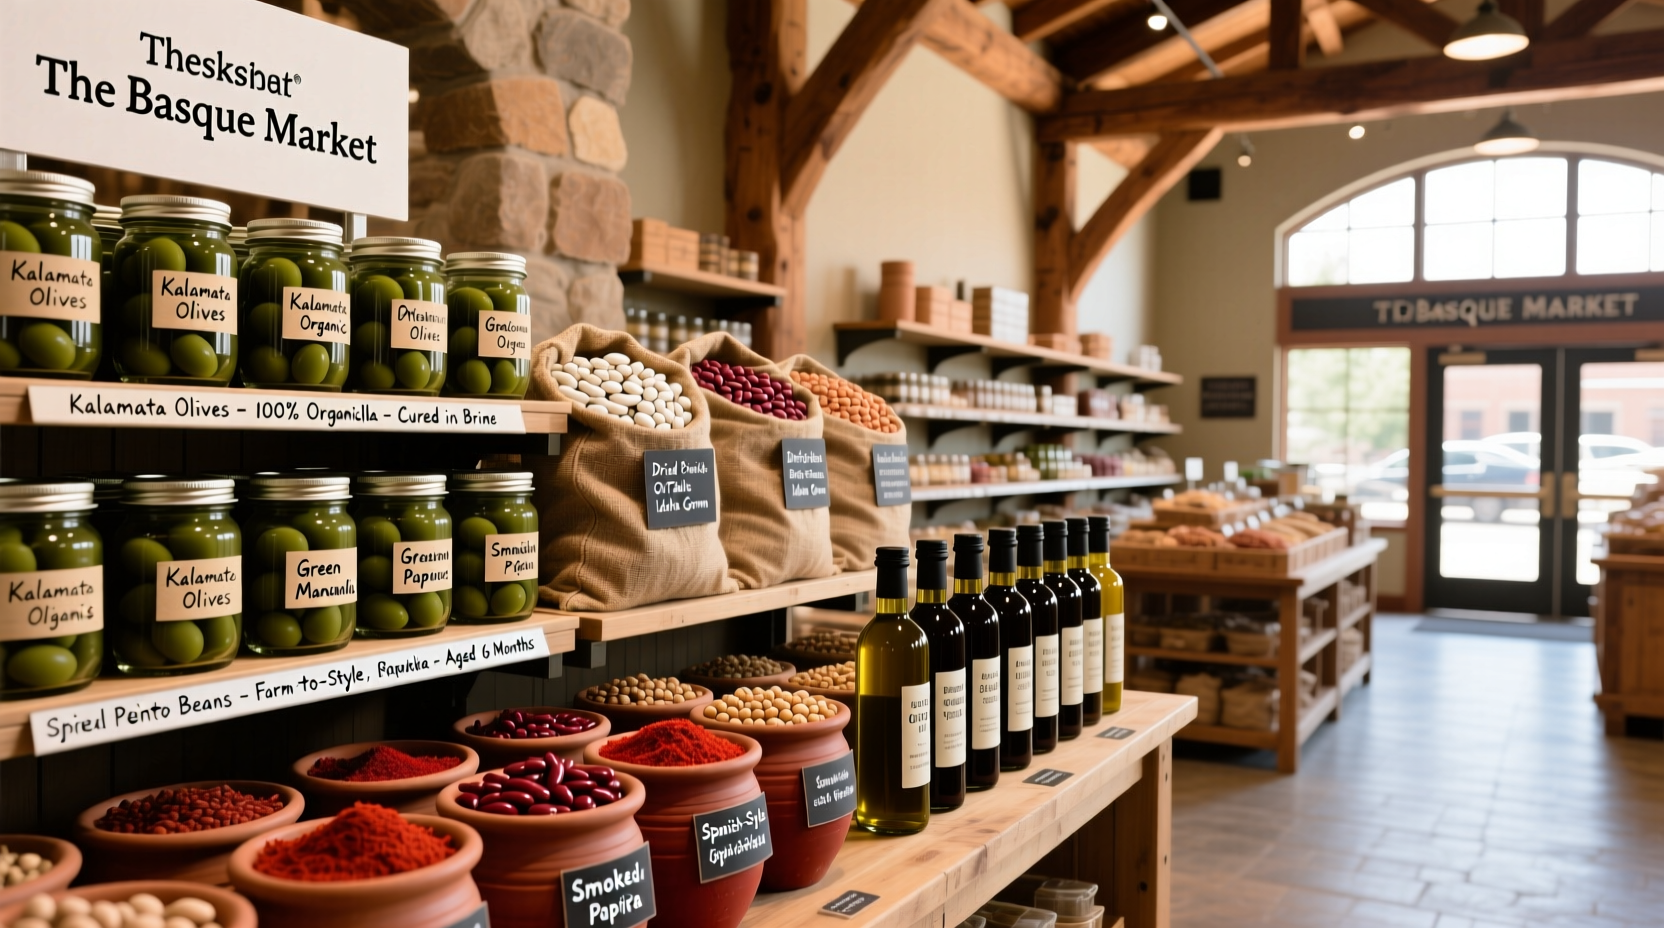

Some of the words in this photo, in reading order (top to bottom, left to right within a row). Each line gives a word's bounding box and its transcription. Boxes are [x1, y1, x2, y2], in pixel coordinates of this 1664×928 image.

[35, 53, 116, 108] The
[125, 74, 256, 141] Basque
[263, 107, 378, 164] Market
[11, 259, 93, 287] Kalamata
[30, 286, 87, 309] Olives
[161, 276, 231, 301] Kalamata
[176, 301, 226, 321] Olives
[1521, 292, 1639, 320] MARKET
[300, 314, 347, 337] Organic
[70, 393, 167, 416] Kalamata
[175, 396, 229, 418] Olives
[256, 401, 299, 420] 100%
[398, 406, 440, 424] Cured
[446, 410, 458, 424] in
[463, 408, 497, 426] Brine
[166, 566, 237, 587] Kalamata
[297, 558, 341, 578] Green
[8, 578, 94, 603] Kalamata
[183, 589, 231, 609] Olives
[178, 694, 232, 716] Beans
[255, 681, 294, 702] Farm
[481, 643, 490, 659] 6
[493, 636, 535, 656] Months
